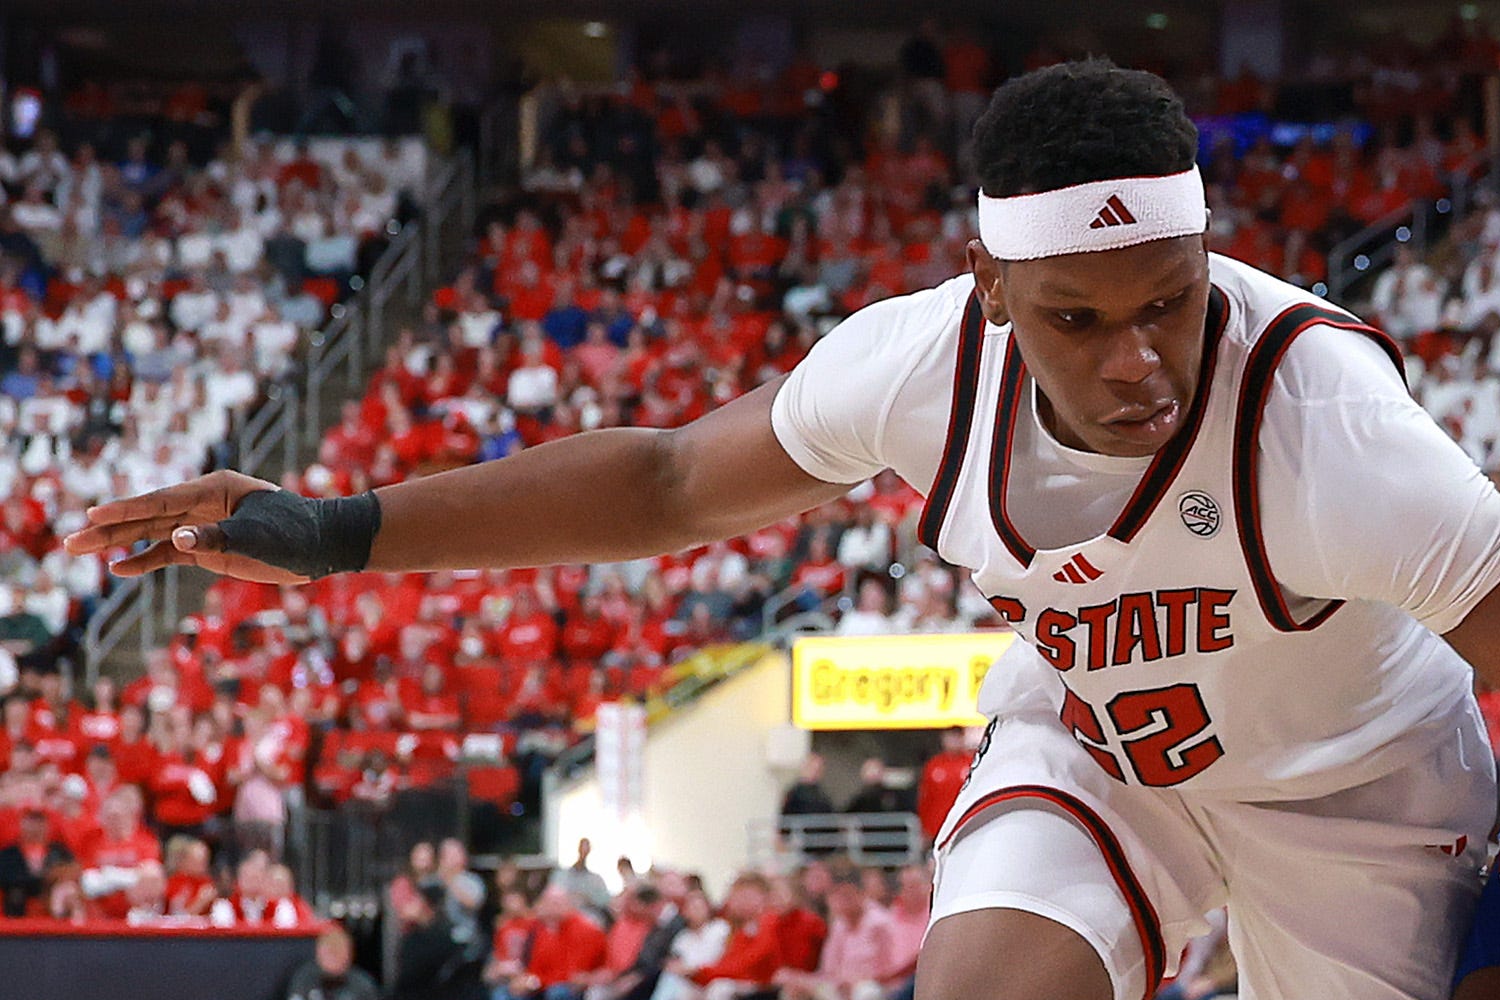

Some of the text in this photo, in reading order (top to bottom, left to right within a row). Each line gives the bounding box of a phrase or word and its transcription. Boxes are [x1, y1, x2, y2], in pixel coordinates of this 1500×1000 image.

[1185, 506, 1217, 521] ACC
[1035, 587, 1238, 672] STATE
[812, 660, 956, 710] Gregory
